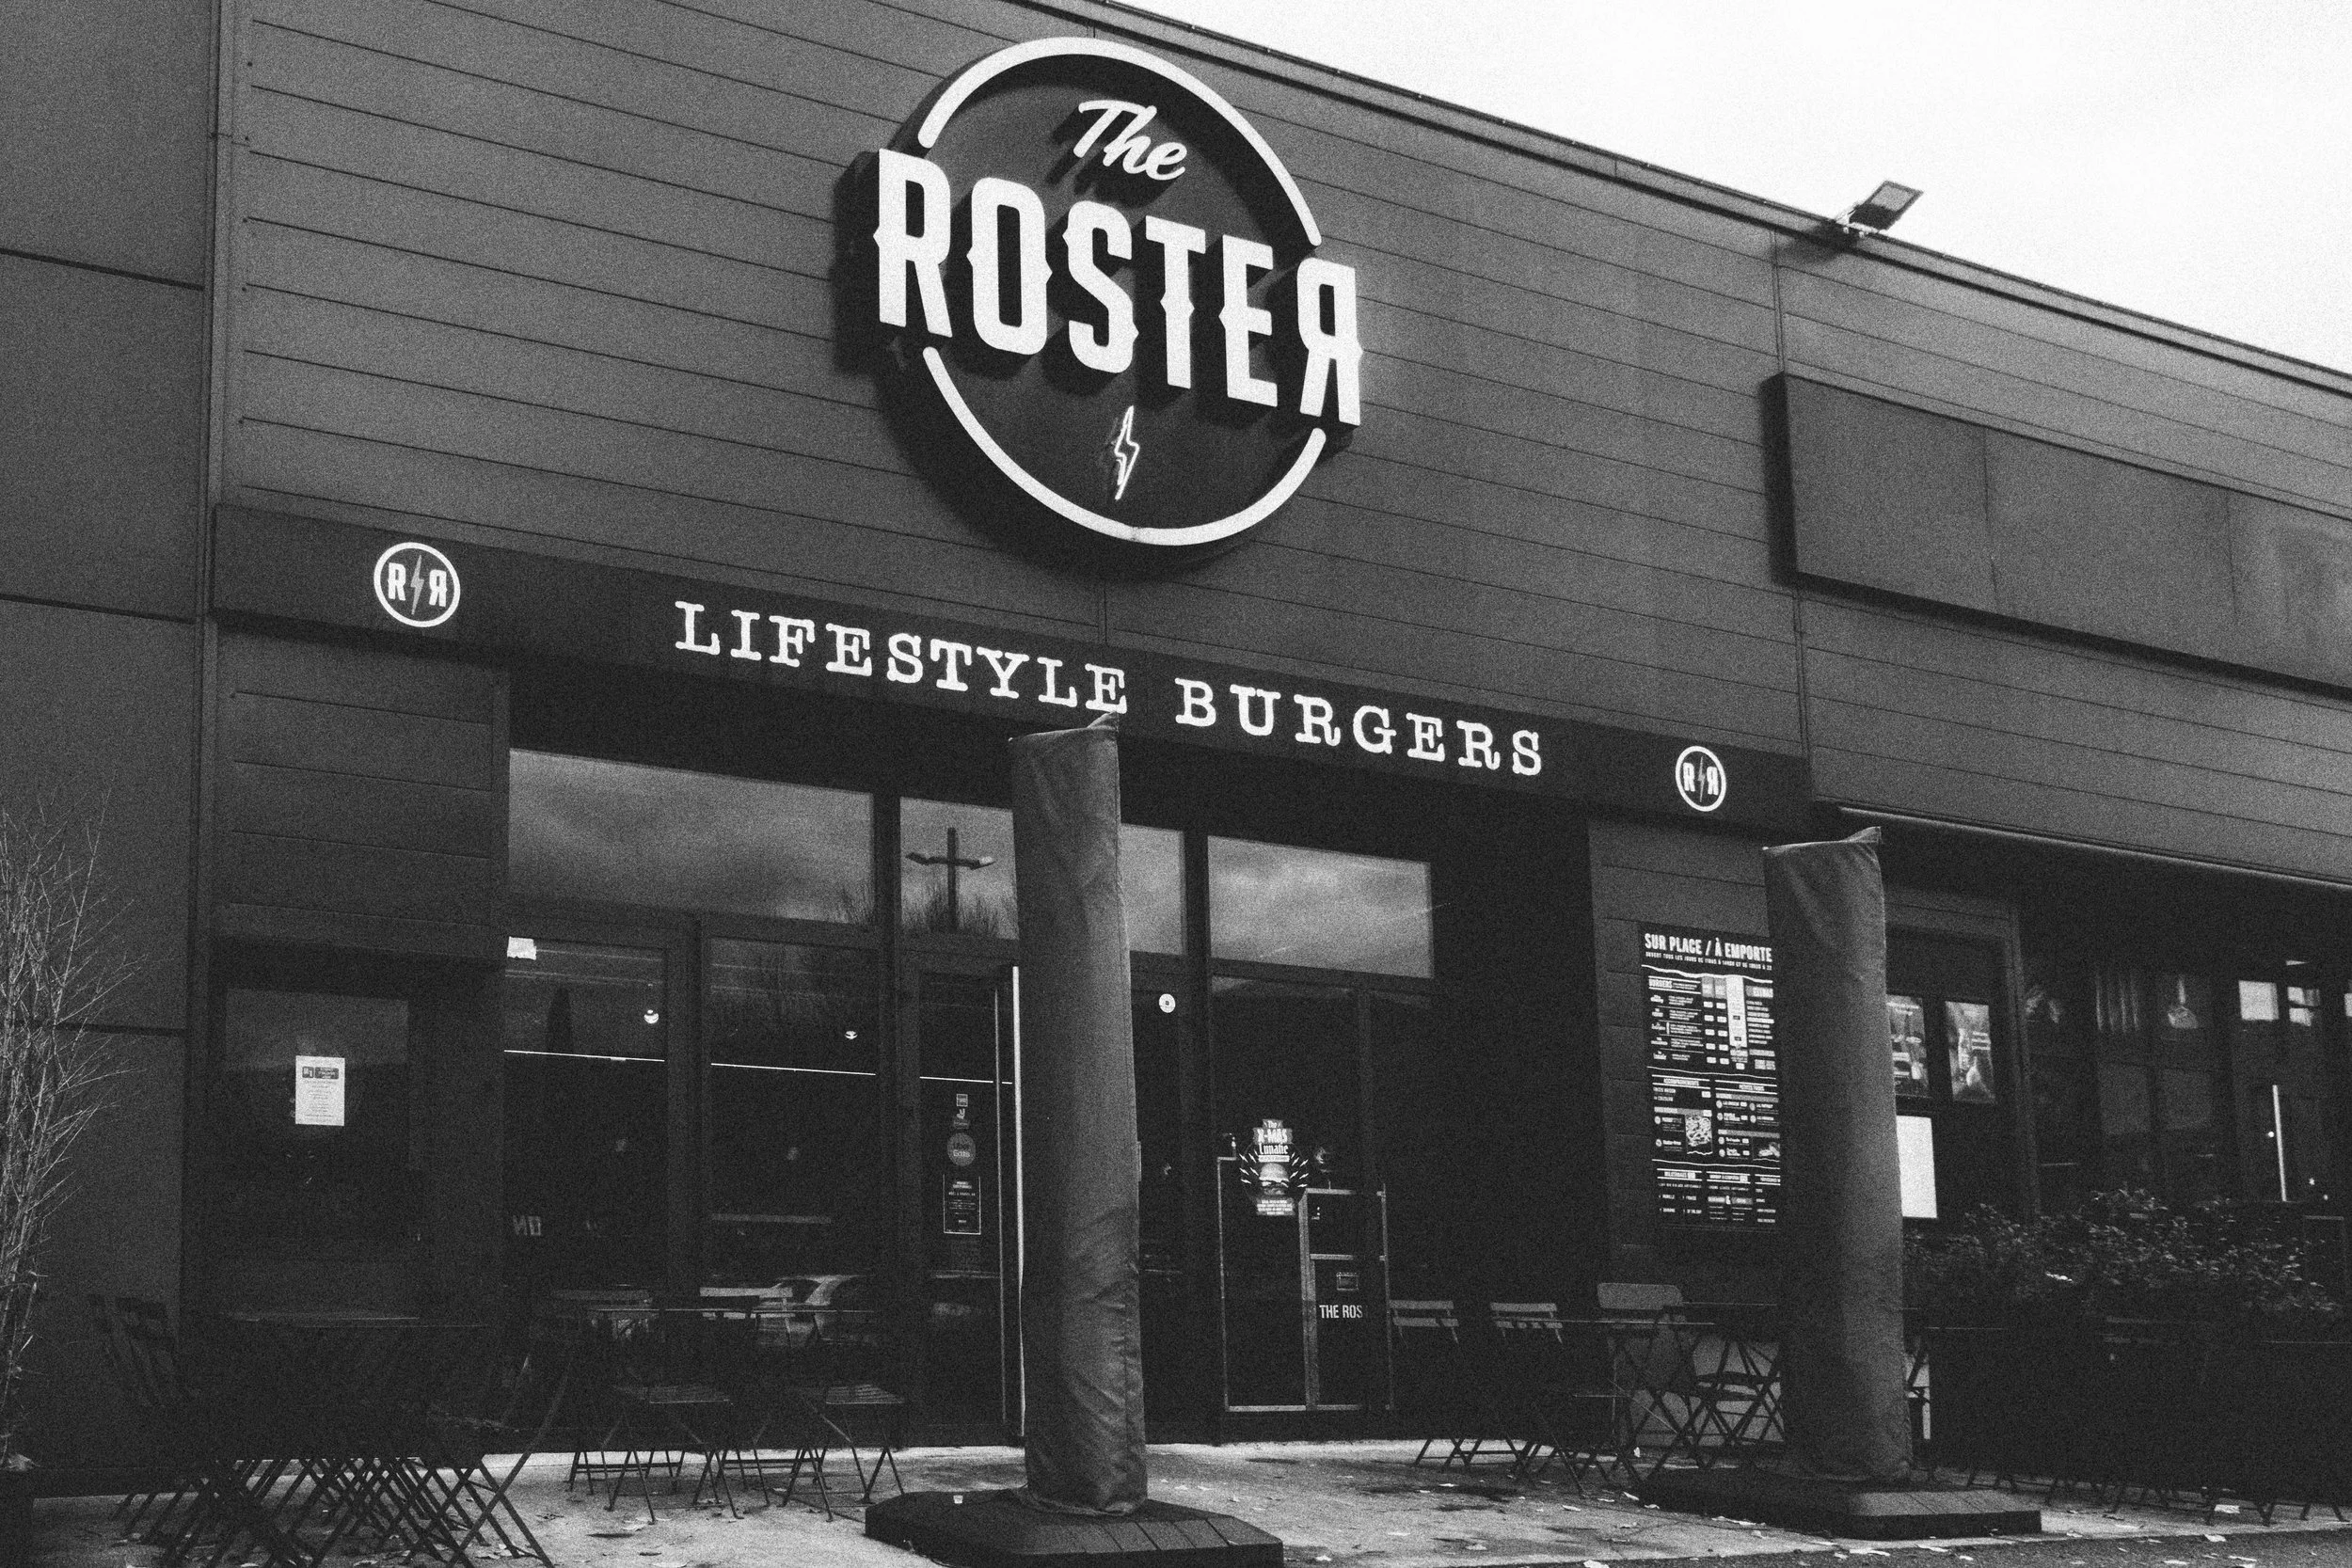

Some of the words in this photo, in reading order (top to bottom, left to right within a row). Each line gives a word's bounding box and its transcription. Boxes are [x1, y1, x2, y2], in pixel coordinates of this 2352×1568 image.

[1078, 100, 1187, 181] The
[873, 148, 1363, 425] ROSTER
[675, 600, 1128, 714] LIFESTYLE
[1174, 677, 1543, 776] BURGERS
[1645, 933, 1666, 950] SUR
[1669, 936, 1702, 955] PLACE
[1715, 937, 1723, 957] À
[1257, 1128, 1287, 1143] X-MAS
[1319, 1304, 1339, 1319] THE
